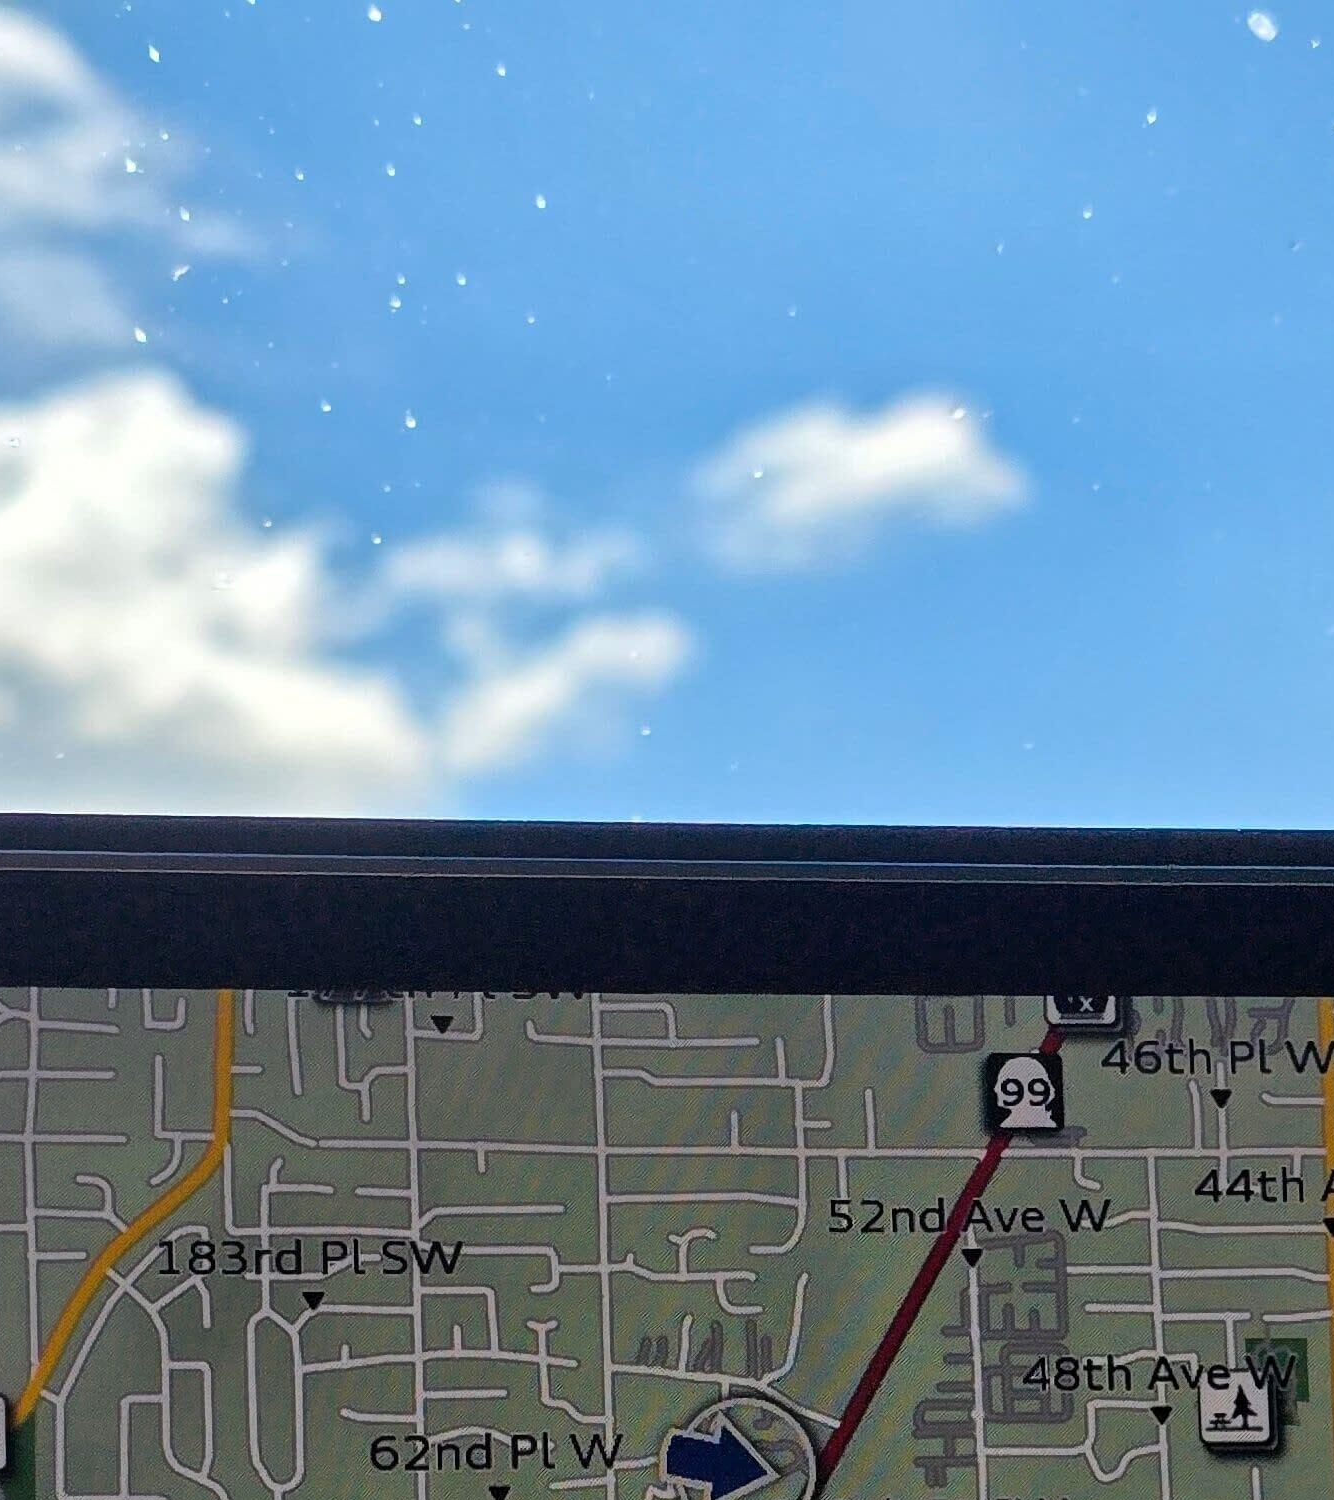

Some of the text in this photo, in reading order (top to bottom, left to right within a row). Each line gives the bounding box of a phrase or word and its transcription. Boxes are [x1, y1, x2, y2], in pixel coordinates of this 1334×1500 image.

[1102, 1039, 1211, 1075] 46th
[1230, 1040, 1271, 1075] Pl
[1001, 1077, 1051, 1107] 99
[1195, 1169, 1304, 1203] 44th
[829, 1199, 1110, 1234] 52nd Ave W
[158, 1240, 464, 1275] 183rd Pl SW
[1022, 1356, 1295, 1391] 48th Ave W
[370, 1433, 623, 1470] 62nd Pl W
